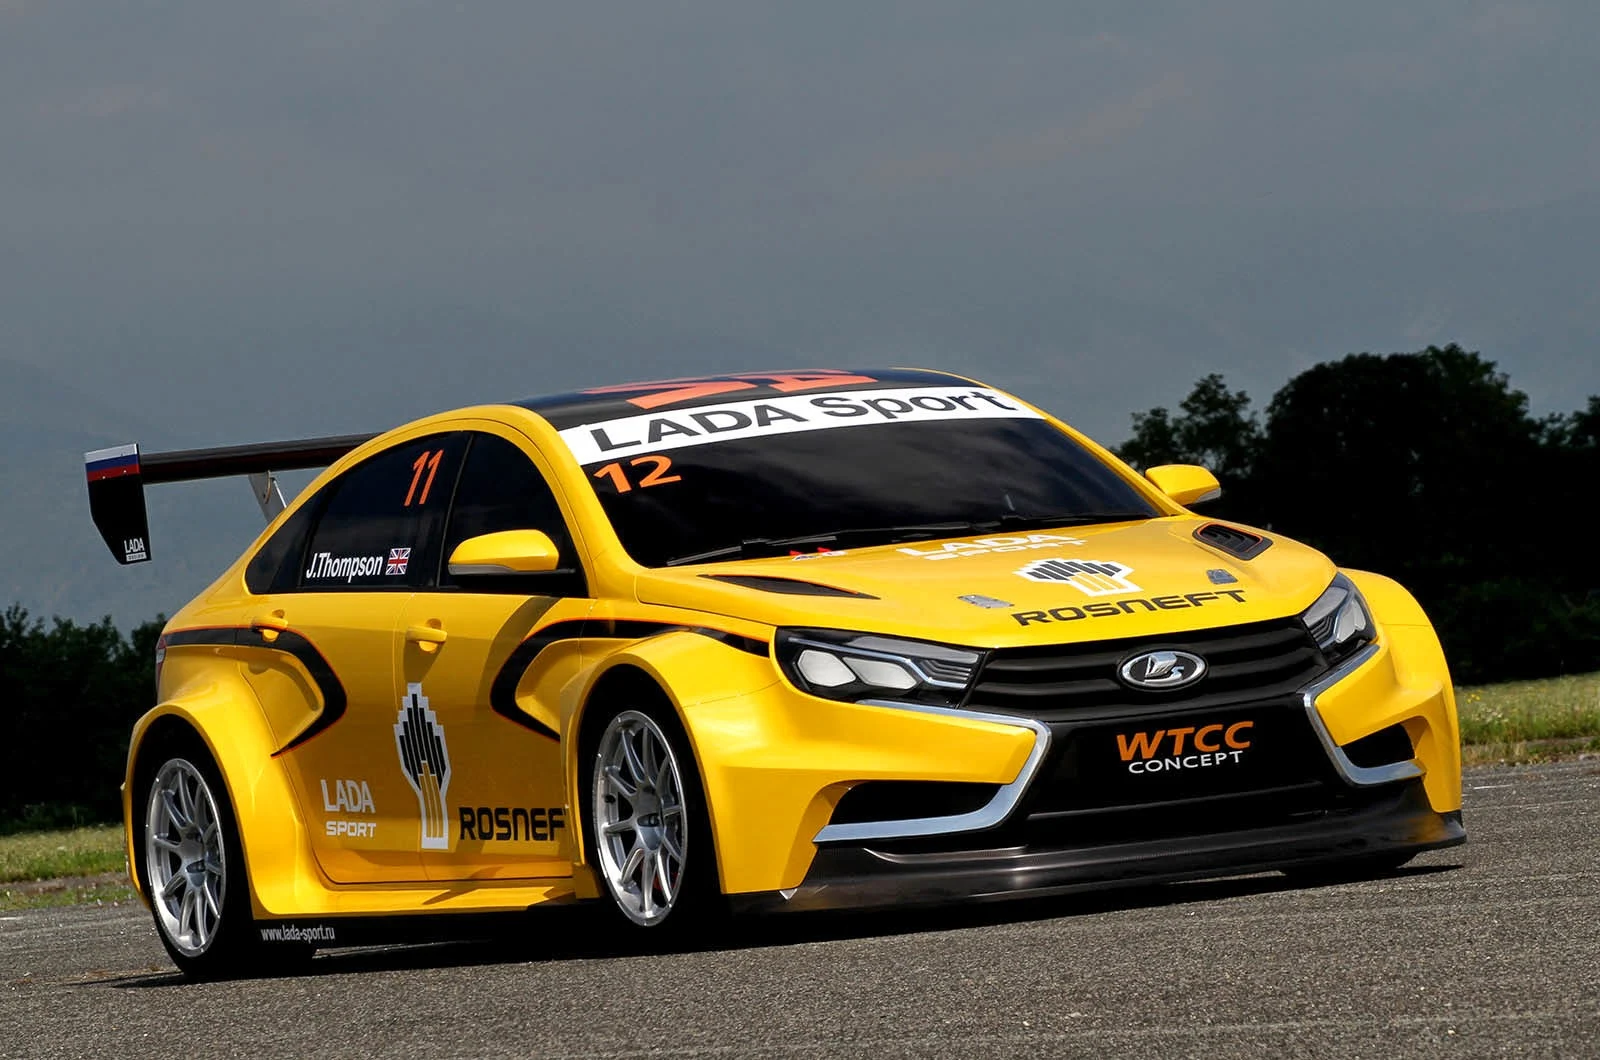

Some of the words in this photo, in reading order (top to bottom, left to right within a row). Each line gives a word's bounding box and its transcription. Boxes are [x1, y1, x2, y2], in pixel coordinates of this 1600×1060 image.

[591, 405, 805, 452] LADA
[811, 389, 1018, 420] Sport
[404, 450, 444, 506] 11
[594, 454, 682, 494] 12
[124, 537, 145, 553] LADA
[896, 534, 1069, 556] LADA
[306, 552, 383, 583] J.Thompson
[1011, 589, 1246, 626] ROSNEFT
[1116, 721, 1255, 761] WTCC
[1128, 750, 1244, 774] CONCEPT
[320, 779, 376, 813] LADA
[326, 820, 377, 838] SPORT
[458, 807, 567, 841] ROSNEF
[261, 924, 335, 944] www.lada-sport.ru
